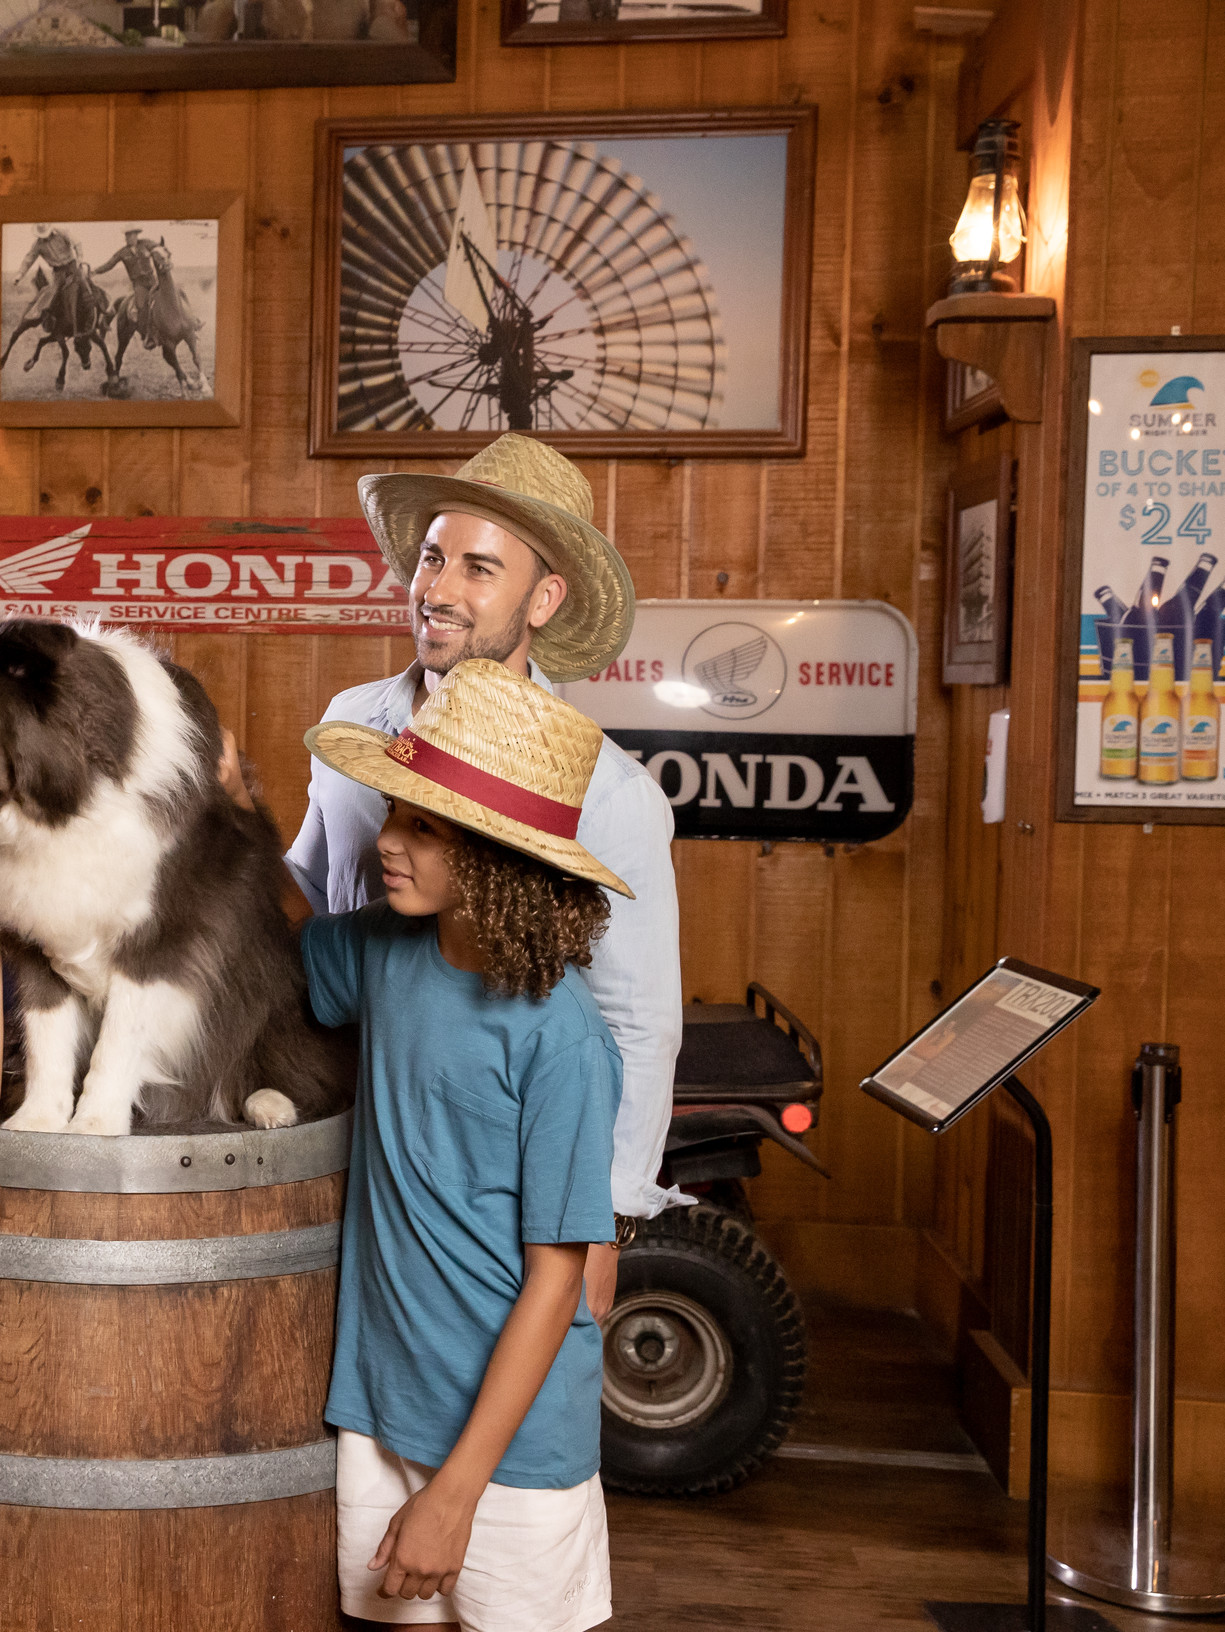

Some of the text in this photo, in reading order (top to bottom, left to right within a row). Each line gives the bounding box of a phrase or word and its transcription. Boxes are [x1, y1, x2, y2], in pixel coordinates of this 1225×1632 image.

[1099, 449, 1225, 477] BUCKE
[1095, 482, 1122, 497] OF
[1126, 482, 1139, 497] 4
[1144, 481, 1173, 497] TO
[1119, 502, 1212, 545] $24
[4, 603, 77, 616] SALES
[109, 605, 206, 619] SERVICE
[214, 606, 307, 620] CENTRE
[798, 661, 895, 687] SERVICE
[623, 749, 895, 813] ONDA
